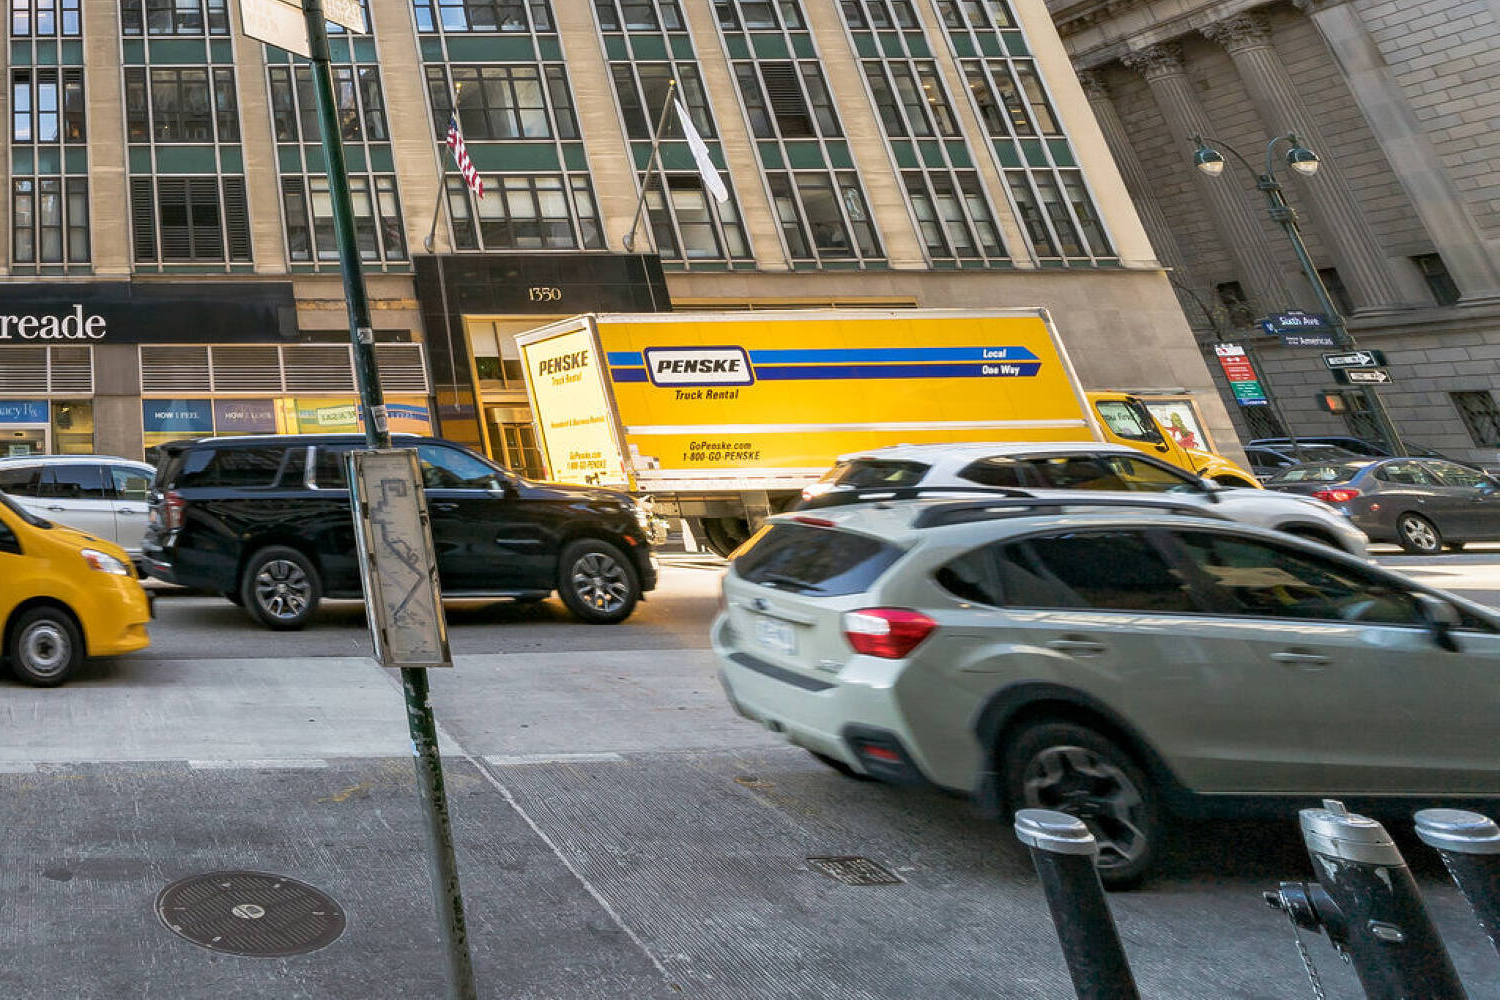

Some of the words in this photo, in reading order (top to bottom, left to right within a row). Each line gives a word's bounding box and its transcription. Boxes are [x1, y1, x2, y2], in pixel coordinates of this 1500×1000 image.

[529, 287, 562, 302] 1350
[982, 348, 1007, 359] Local
[538, 350, 589, 376] PENSKE
[657, 359, 741, 374] PENSKE
[982, 364, 1000, 375] One
[1000, 364, 1021, 377] Way
[674, 389, 703, 401] Truck
[705, 388, 739, 400] Rental
